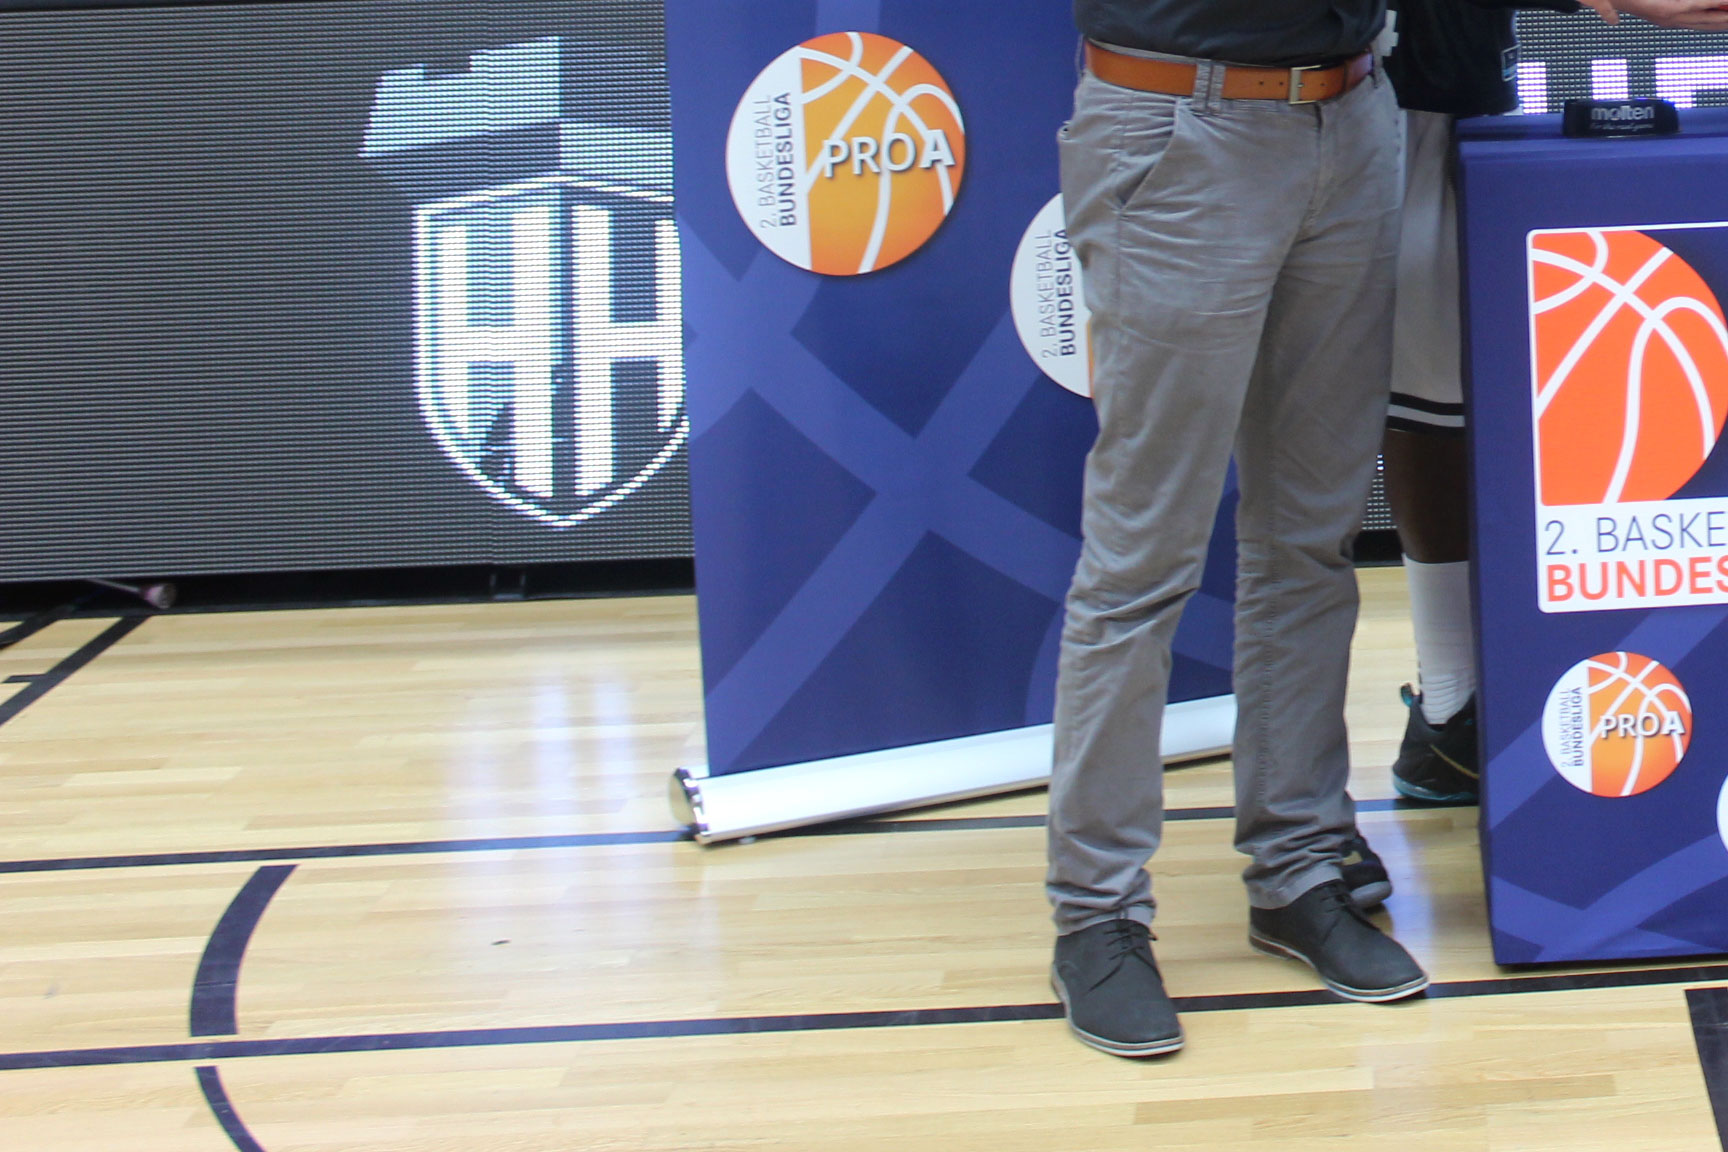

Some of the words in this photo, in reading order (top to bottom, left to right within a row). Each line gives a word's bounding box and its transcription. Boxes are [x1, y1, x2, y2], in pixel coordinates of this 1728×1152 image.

[753, 96, 777, 207] BASKETBALL
[774, 92, 797, 226] BUNDESLIGA
[1591, 105, 1655, 121] molten
[1035, 230, 1056, 338] BASKETBALL
[1054, 229, 1077, 356] BUNDESLIGA
[1545, 519, 1579, 555] 2.
